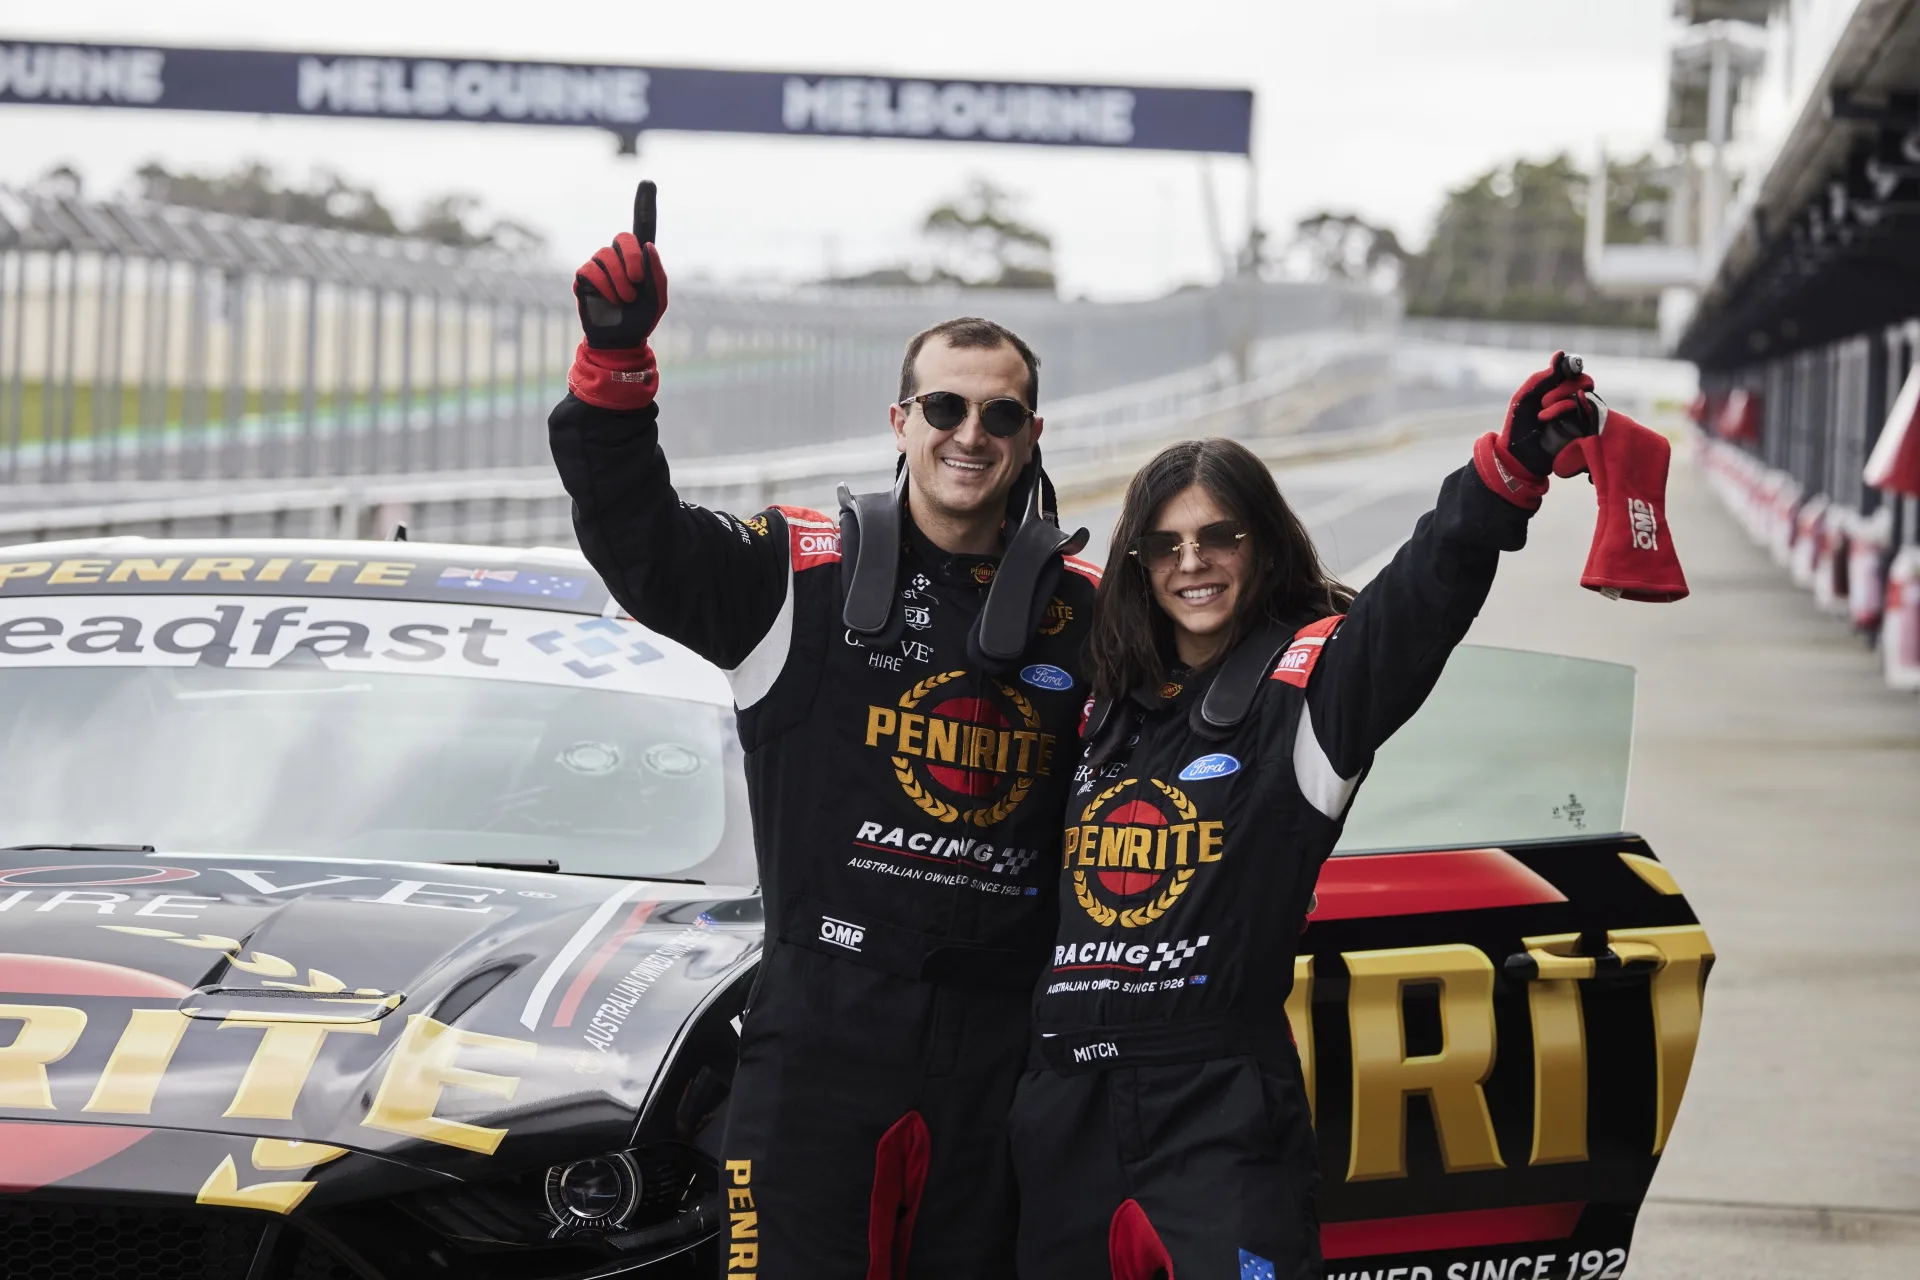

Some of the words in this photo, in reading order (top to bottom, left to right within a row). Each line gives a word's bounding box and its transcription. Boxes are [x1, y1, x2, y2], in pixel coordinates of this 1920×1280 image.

[298, 55, 650, 123] MELBOURNE
[782, 74, 1136, 144] MELBOURNE
[1630, 498, 1655, 551] OMP
[0, 558, 417, 588] PENRITE
[970, 567, 996, 578] PENRIT
[0, 605, 507, 667] eadfast
[868, 652, 904, 672] HIRE
[1277, 650, 1309, 670] MP
[1031, 664, 1065, 688] Ford
[864, 705, 1057, 777] PENRITE
[1188, 758, 1228, 777] Ford
[856, 821, 994, 862] RACING
[1063, 820, 1225, 869] PENRITE
[847, 858, 924, 880] AUSTRALIAN
[970, 878, 1001, 894] SINCE
[1000, 885, 1021, 896] 1926
[820, 919, 865, 949] OMP
[1053, 940, 1150, 966] RACING
[1046, 980, 1090, 995] AUSTRALIAN
[1122, 982, 1157, 994] SINCE
[1158, 977, 1185, 991] 1926
[583, 976, 650, 1053] AUSTRALIAN
[629, 953, 675, 984] OWNED
[1073, 1042, 1119, 1063] MITCH
